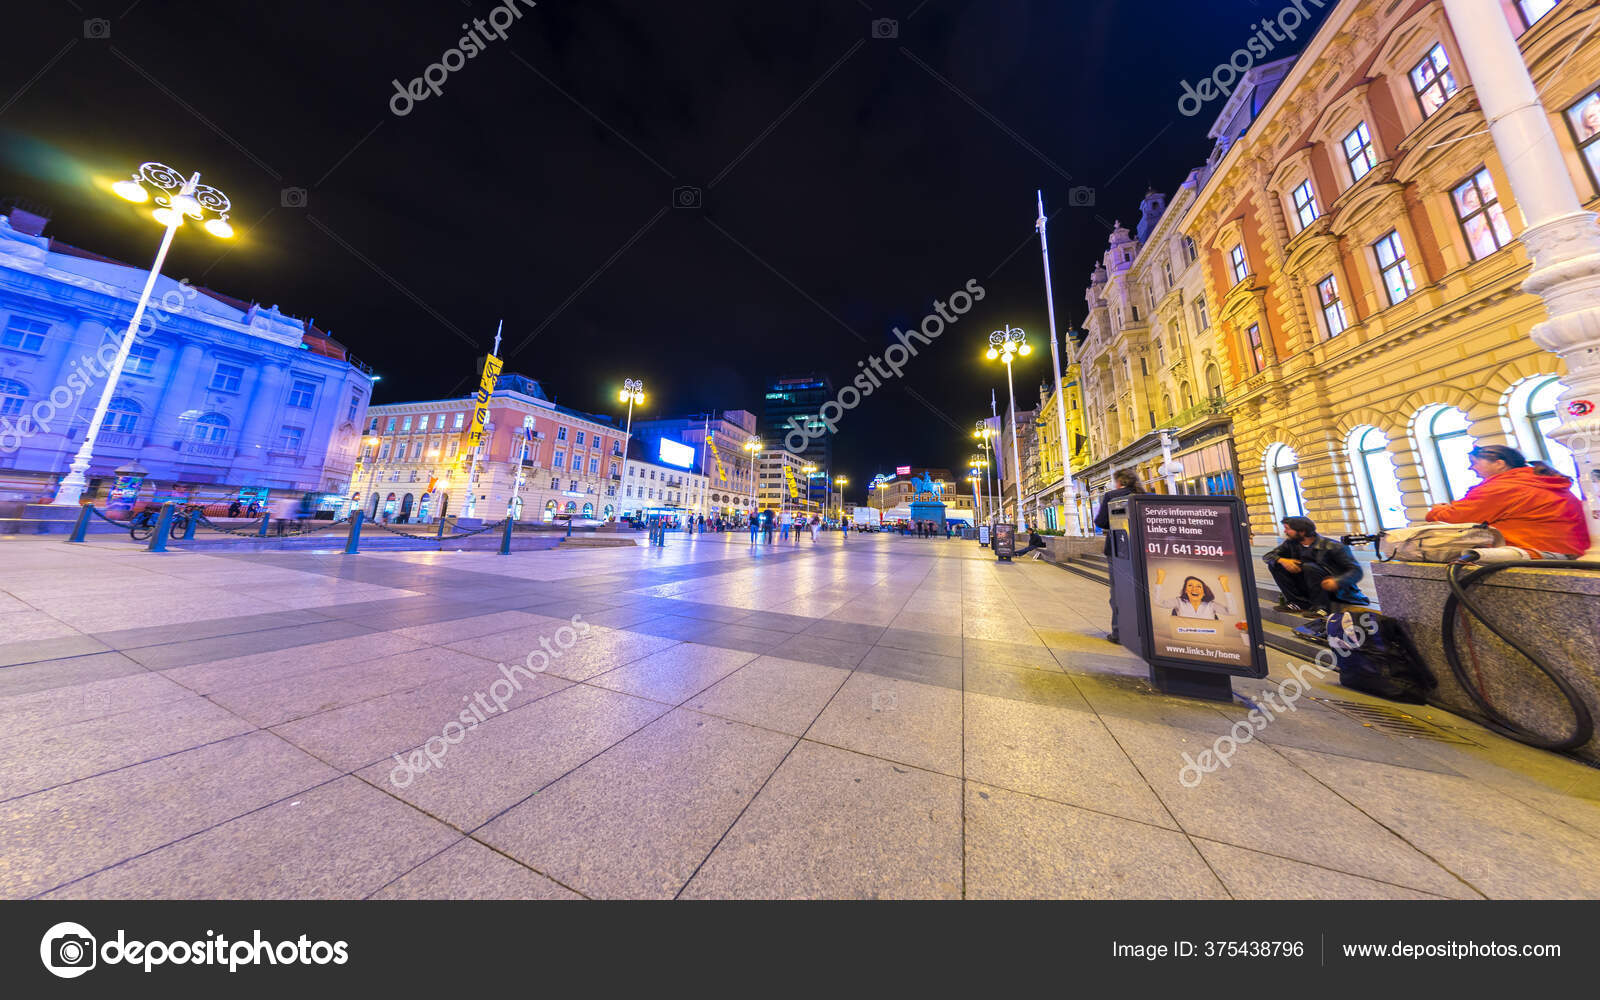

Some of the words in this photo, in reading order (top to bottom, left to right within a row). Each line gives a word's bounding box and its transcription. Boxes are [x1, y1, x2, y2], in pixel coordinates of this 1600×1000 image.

[1145, 507, 1168, 516] Servis
[1169, 508, 1218, 517] informatičke
[1146, 517, 1175, 525] opreme
[1188, 518, 1214, 526] terenu
[1147, 525, 1168, 534] Links
[1169, 525, 1177, 534] @
[1179, 526, 1203, 535] Home
[1148, 542, 1161, 553] 01
[1164, 543, 1169, 555] /
[1172, 544, 1192, 555] 641
[1194, 544, 1224, 556] 3904
[1166, 645, 1241, 660] www.links.hr/home
